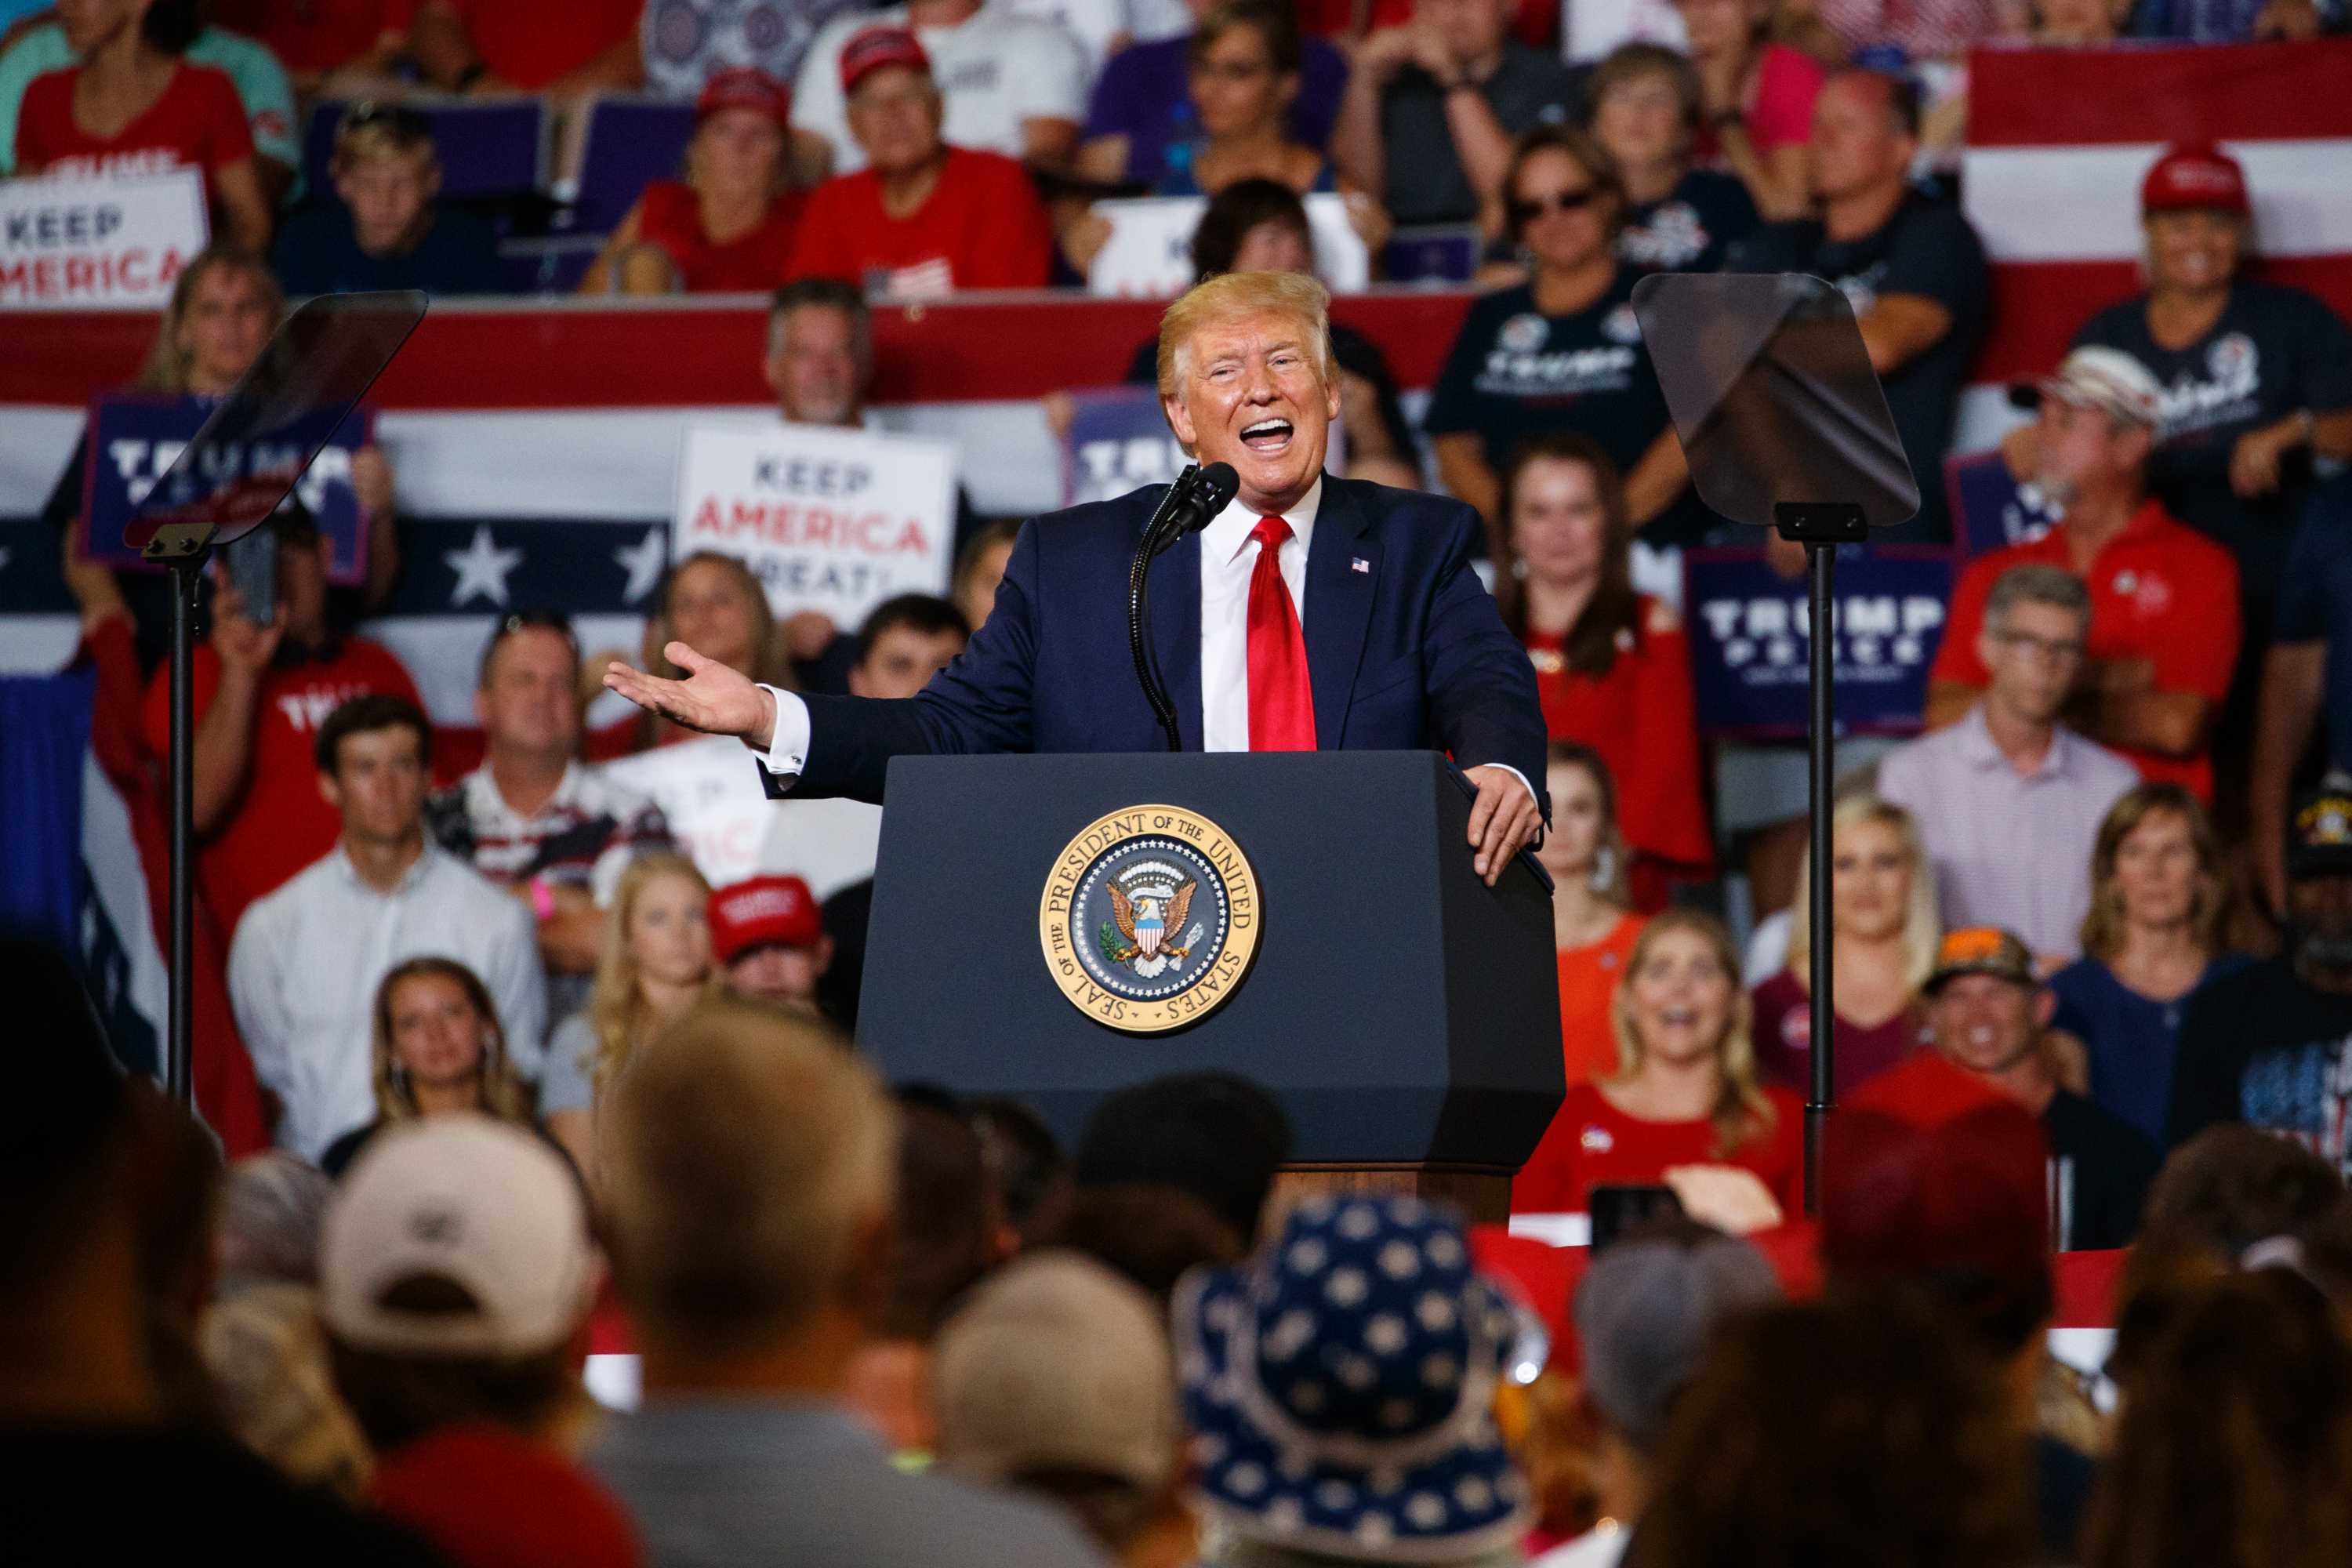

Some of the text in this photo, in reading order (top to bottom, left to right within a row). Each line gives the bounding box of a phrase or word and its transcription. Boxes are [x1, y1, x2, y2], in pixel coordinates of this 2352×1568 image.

[5, 206, 122, 248] KEEP
[0, 249, 188, 298] MERICA
[754, 456, 872, 495] KEEP
[693, 495, 931, 557] AMERICA
[756, 555, 891, 594] REAT!
[1049, 814, 1251, 1020] SEAL OF THE PRESIDENT OF THE UNITED STATES
